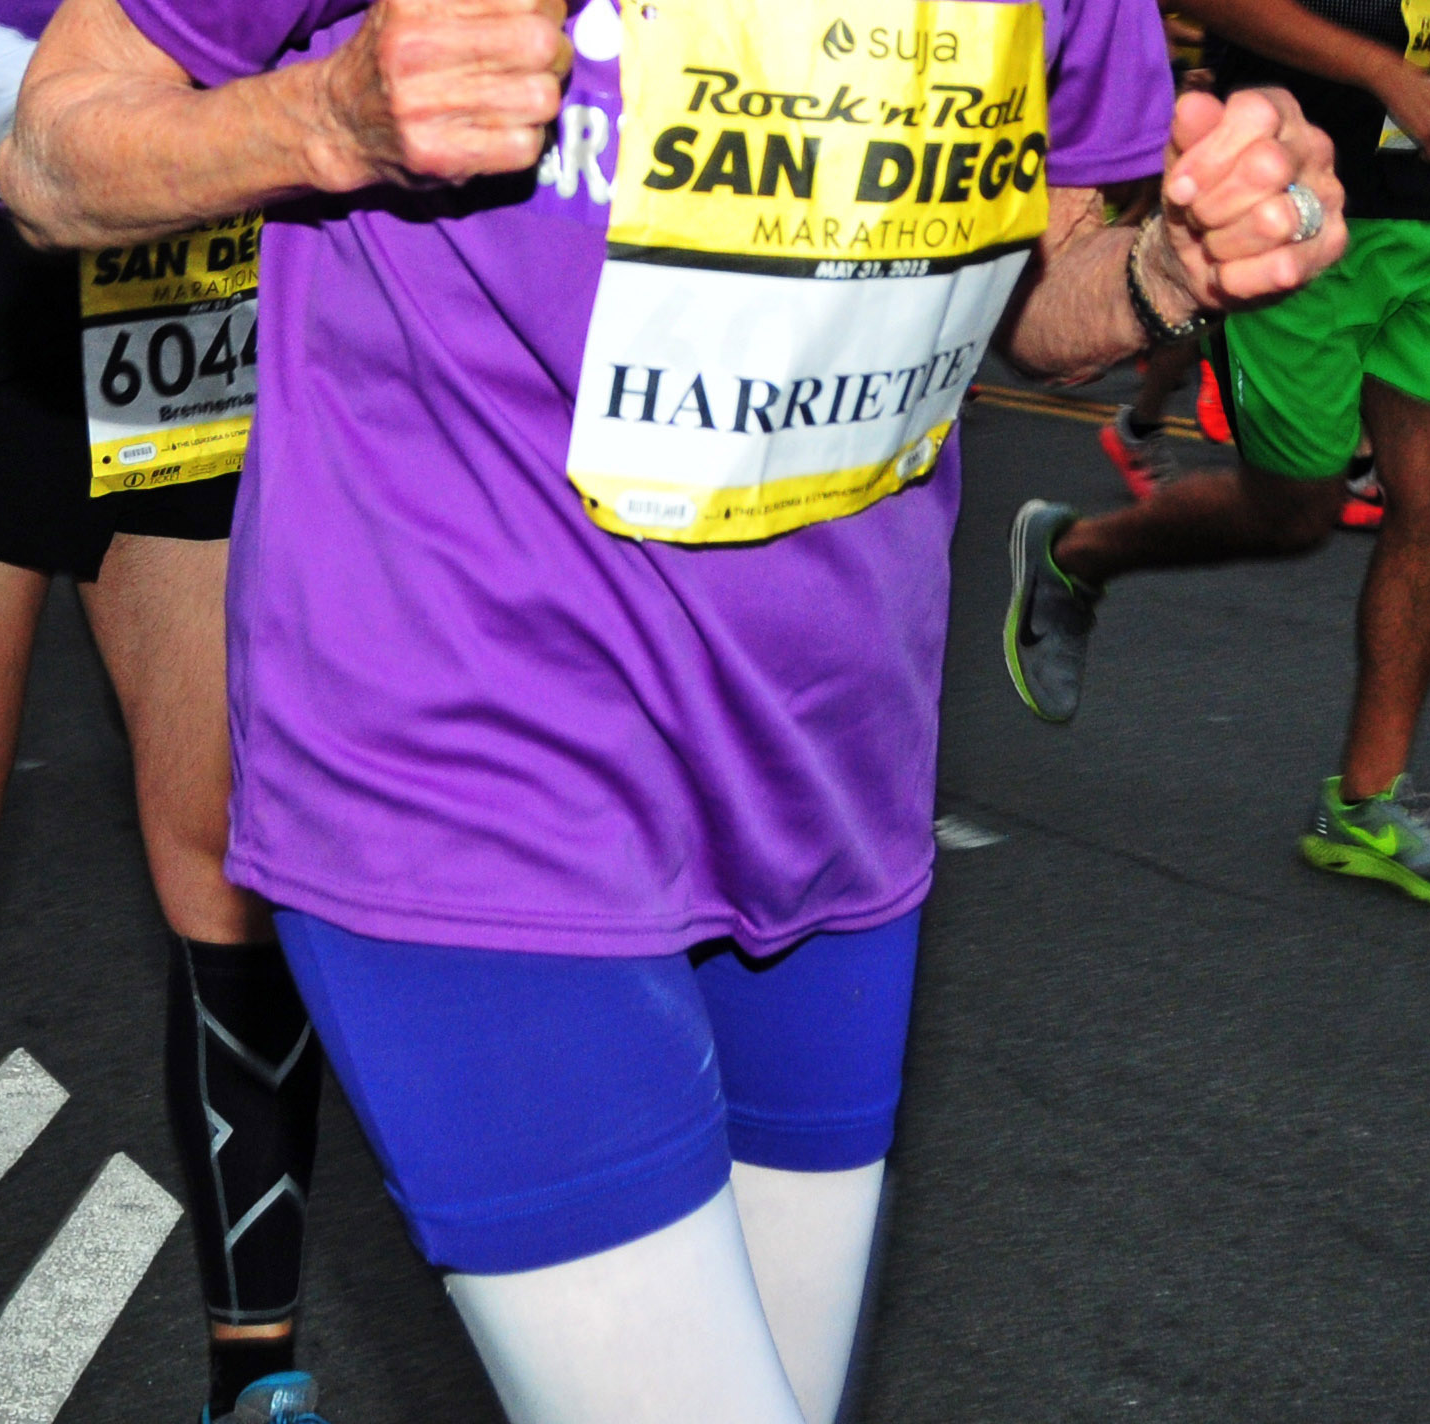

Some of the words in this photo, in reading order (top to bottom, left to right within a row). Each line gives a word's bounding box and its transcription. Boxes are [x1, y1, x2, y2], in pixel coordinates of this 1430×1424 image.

[868, 27, 958, 75] suja
[683, 67, 872, 125] Rock
[879, 100, 925, 127] 'n'
[930, 84, 1028, 129] Roll
[642, 125, 822, 199] SAN
[855, 132, 1048, 204] DIEGO
[752, 216, 976, 249] MARATHON
[92, 240, 190, 286] SAN
[814, 260, 858, 279] MAY
[600, 341, 975, 435] HARRIETTE
[152, 465, 181, 477] BEER
